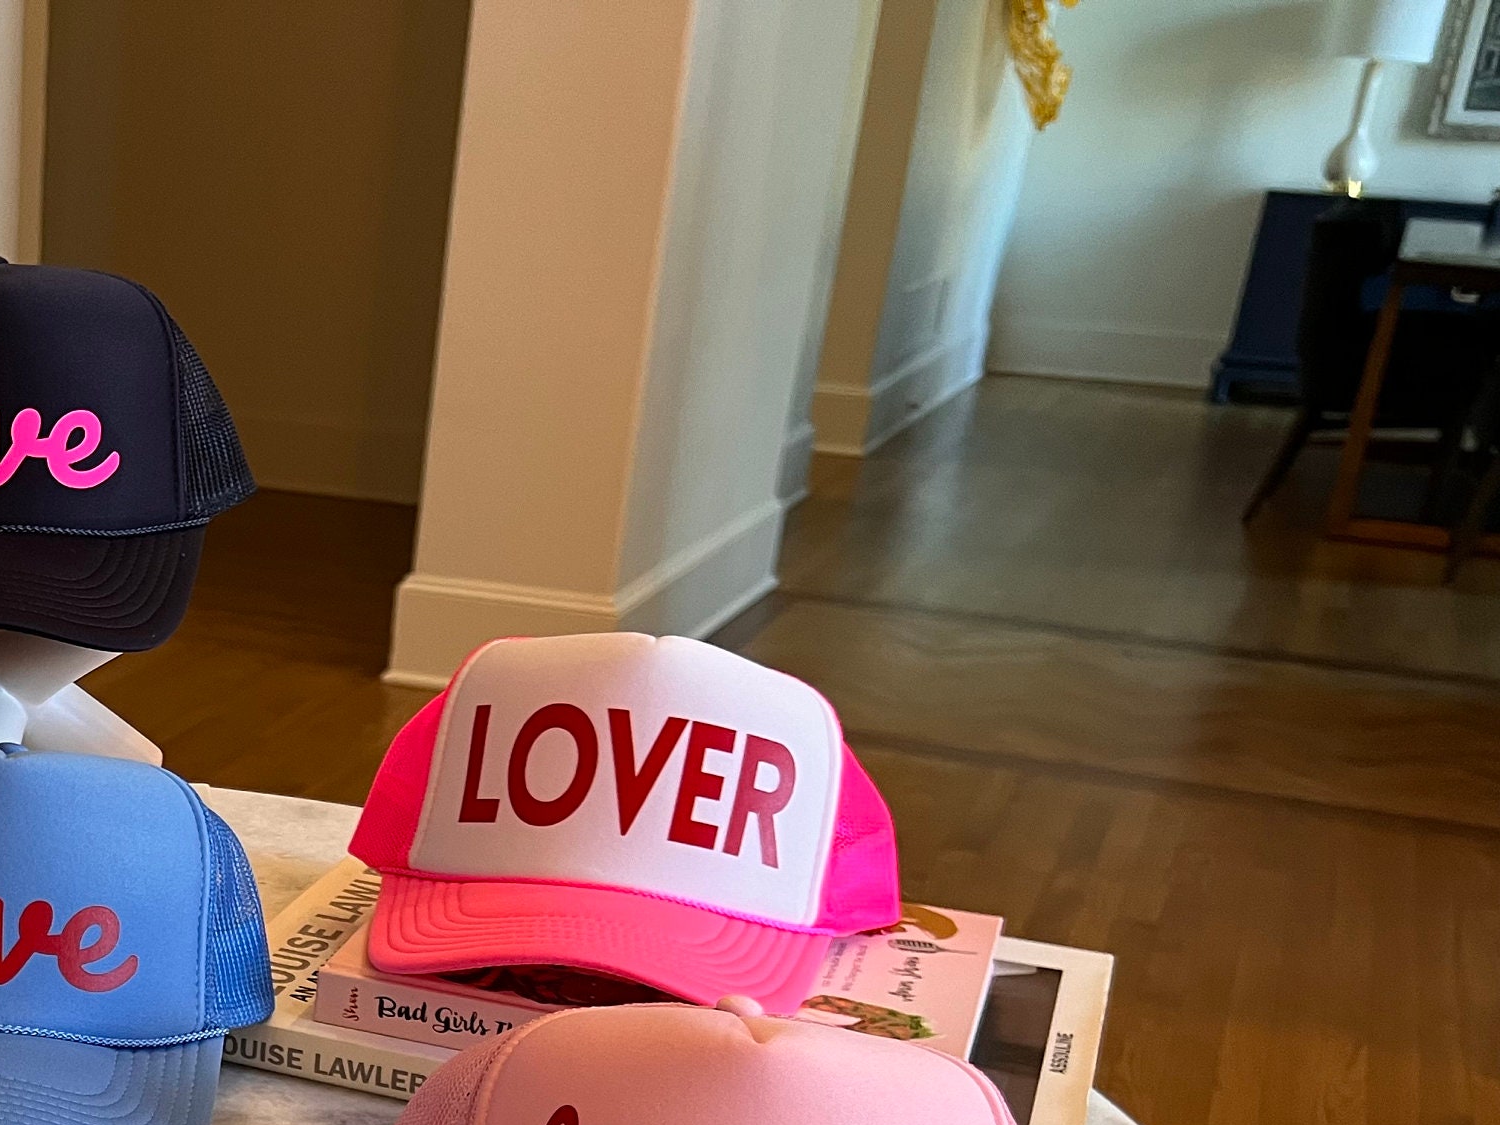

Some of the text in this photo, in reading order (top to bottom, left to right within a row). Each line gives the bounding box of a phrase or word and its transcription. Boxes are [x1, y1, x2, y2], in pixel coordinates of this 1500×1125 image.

[458, 703, 796, 869] LOVER
[271, 924, 344, 996] OUISE
[374, 996, 428, 1023] Bad
[432, 1007, 491, 1036] Girls
[223, 1035, 304, 1070] OUISE
